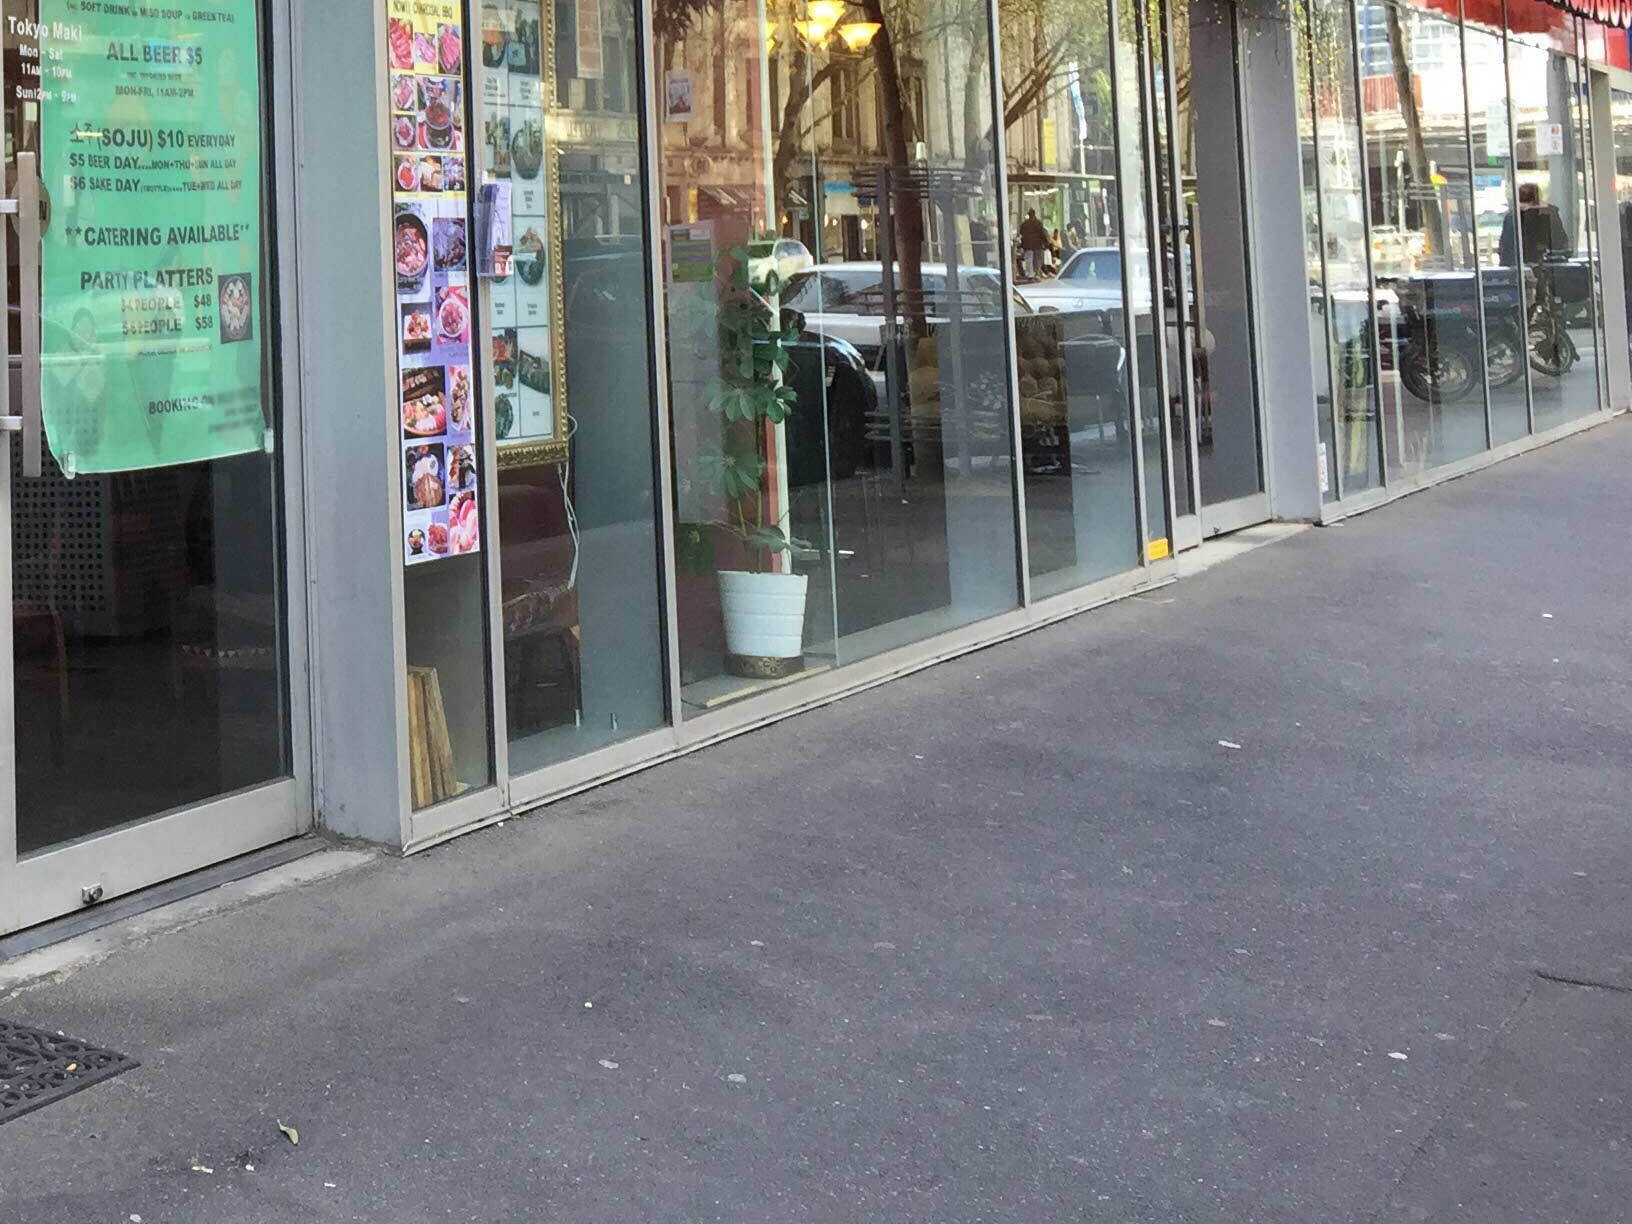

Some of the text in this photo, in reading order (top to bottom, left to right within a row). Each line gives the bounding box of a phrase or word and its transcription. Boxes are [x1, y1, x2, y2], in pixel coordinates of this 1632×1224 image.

[8, 16, 82, 41] Tokyo Maki
[107, 41, 139, 61] ALL
[143, 45, 182, 64] BEER
[157, 129, 185, 150] $10
[188, 135, 235, 148] EVERYDAY
[69, 153, 85, 168] $5
[70, 176, 86, 191] $6
[89, 177, 113, 191] SAKE
[81, 271, 128, 290] PARTY
